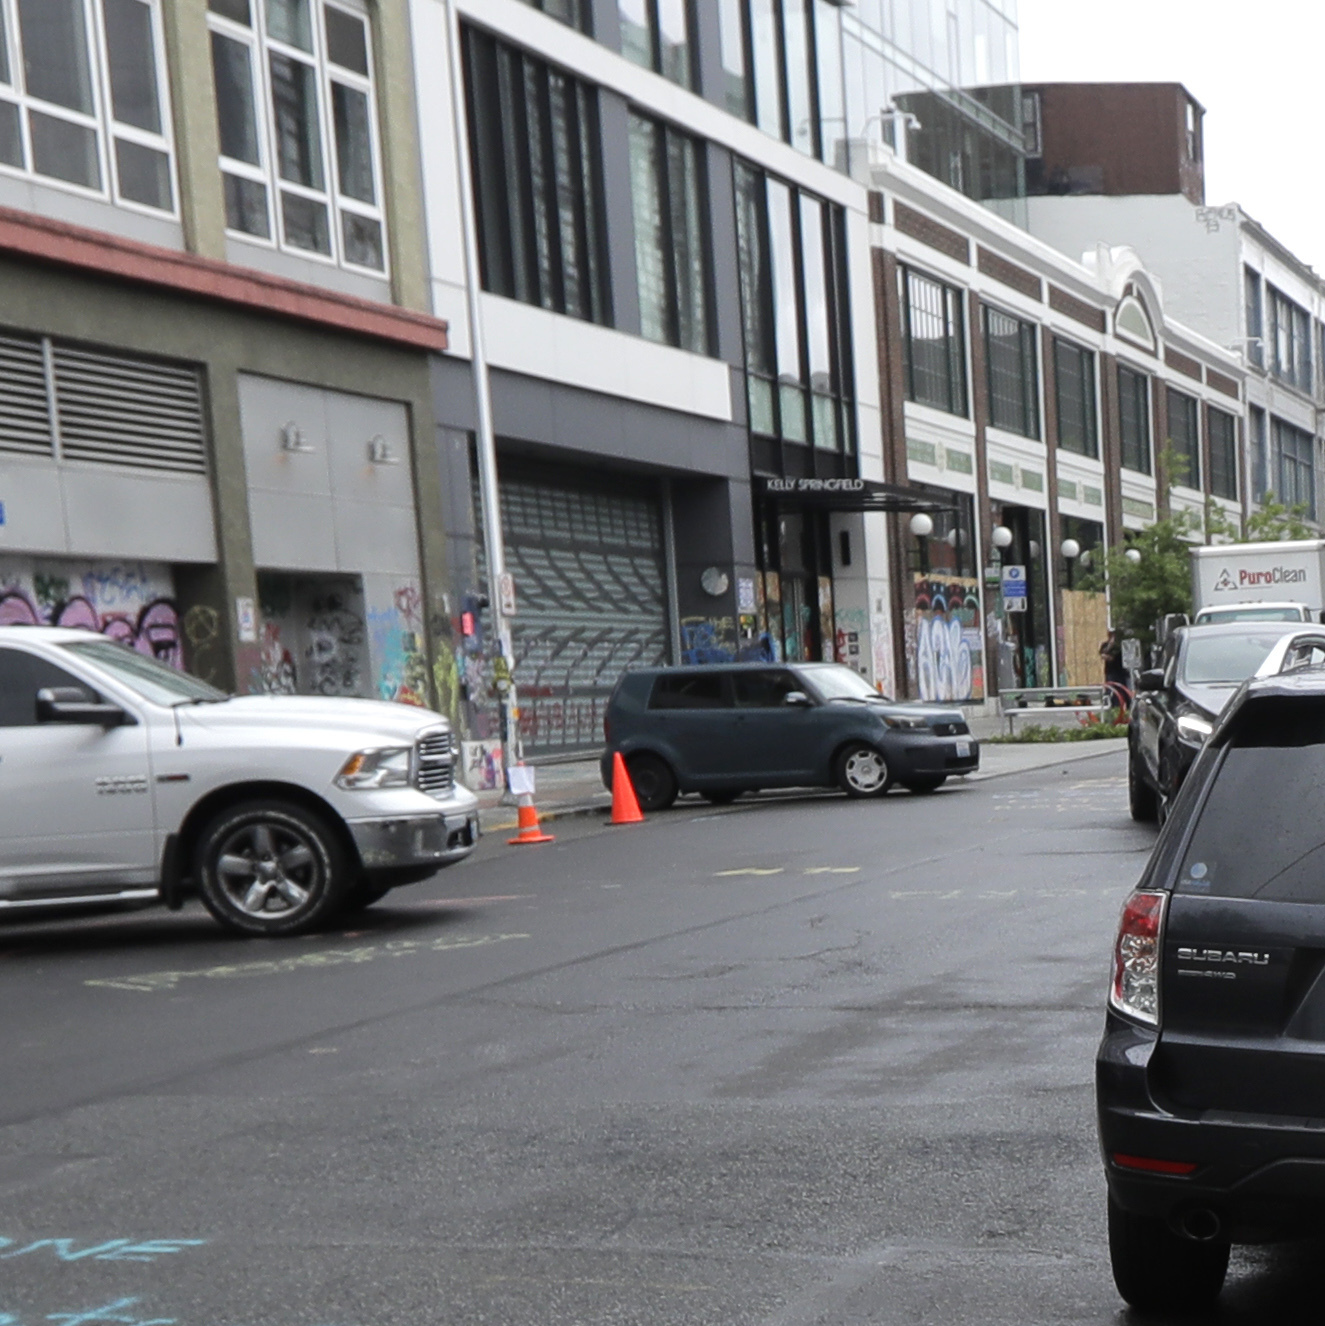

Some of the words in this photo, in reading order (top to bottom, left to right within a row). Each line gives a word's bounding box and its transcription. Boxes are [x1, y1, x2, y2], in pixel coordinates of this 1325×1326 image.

[766, 478, 796, 491] KELLY
[798, 478, 865, 491] SPRINGFIELD
[1239, 566, 1307, 586] PuroClean
[1177, 947, 1270, 965] SUBARU
